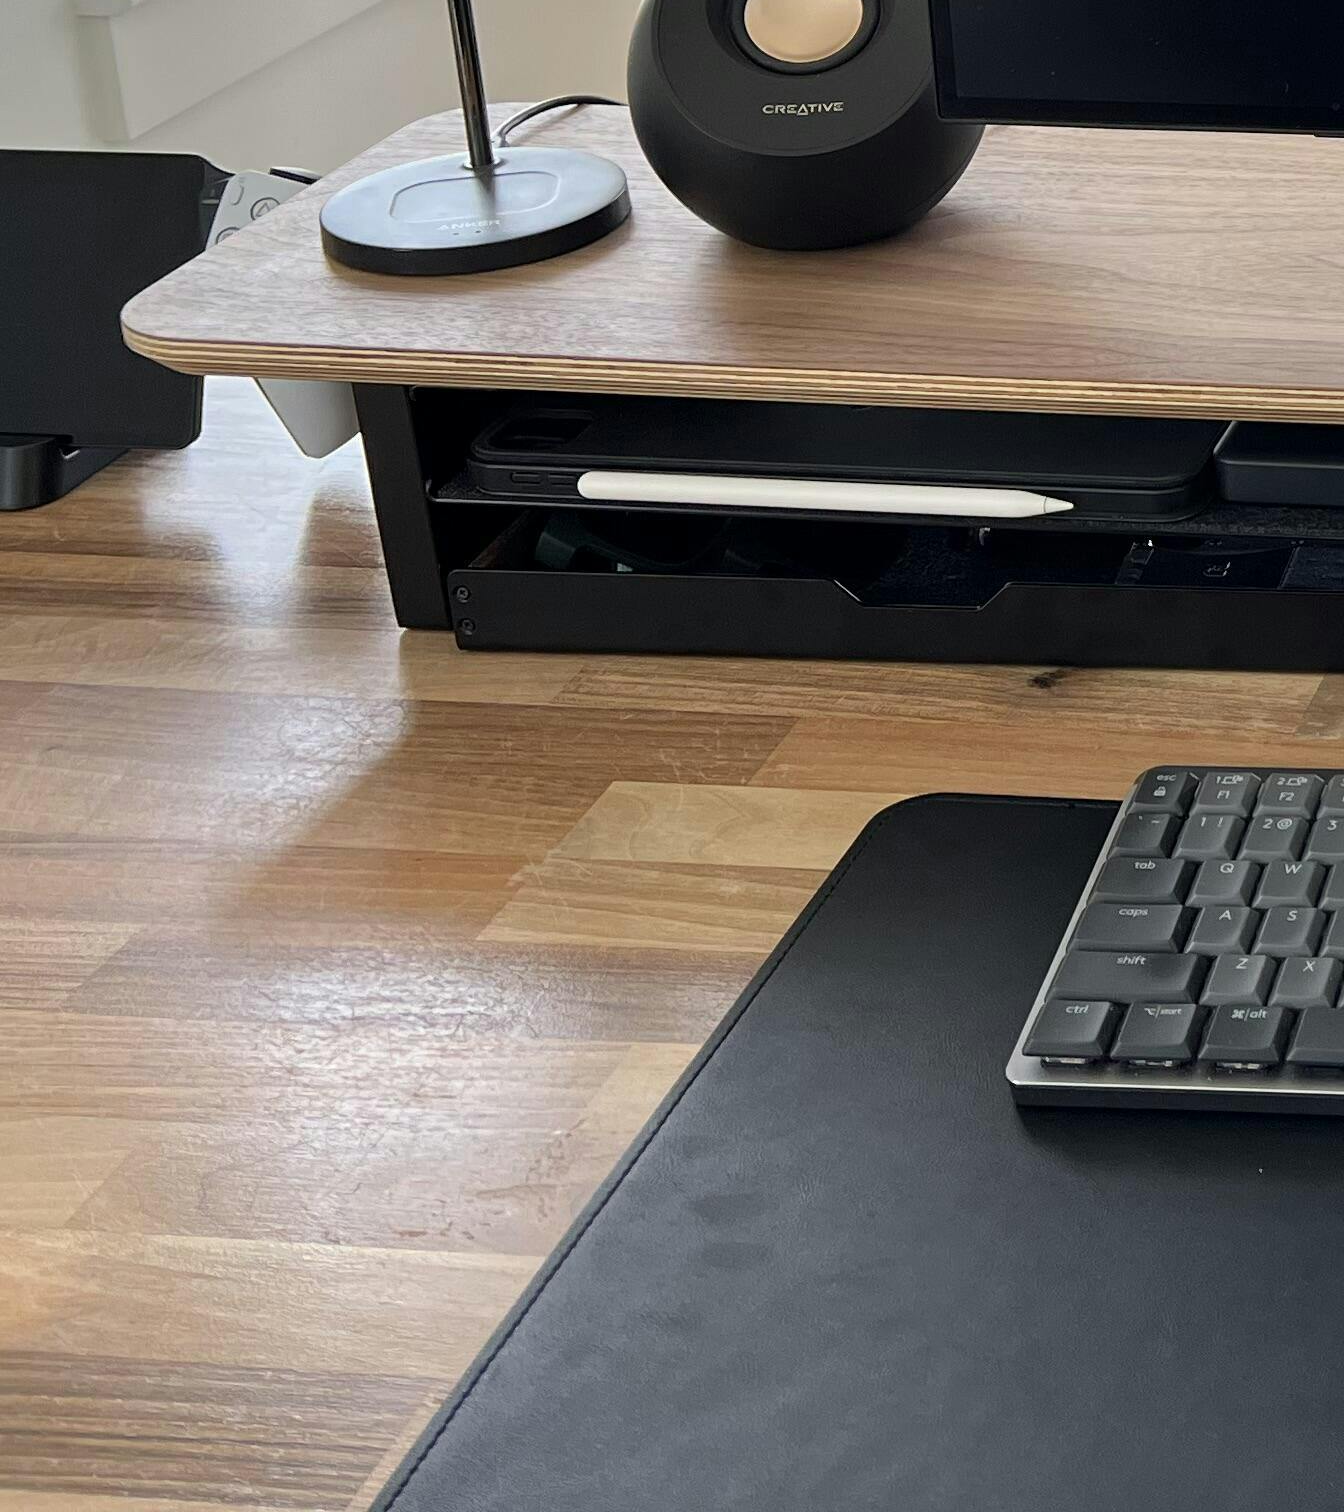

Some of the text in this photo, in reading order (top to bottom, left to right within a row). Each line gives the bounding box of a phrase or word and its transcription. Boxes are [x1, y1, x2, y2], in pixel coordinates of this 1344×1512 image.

[762, 102, 844, 116] CREATIVE
[1156, 774, 1177, 782] esc
[1217, 790, 1230, 800] F1
[1279, 792, 1295, 801] F2
[1200, 816, 1206, 827] 1
[1263, 819, 1273, 830] 2
[1327, 820, 1338, 831] 3
[1134, 861, 1156, 870] tab
[1219, 862, 1234, 874] Q
[1284, 863, 1303, 875] W
[1118, 907, 1149, 917] caps
[1218, 909, 1232, 921] A
[1286, 909, 1298, 921] S
[1116, 955, 1145, 966] shift
[1235, 958, 1248, 970] Z
[1302, 960, 1316, 972] X
[1065, 1005, 1089, 1015] ctrl
